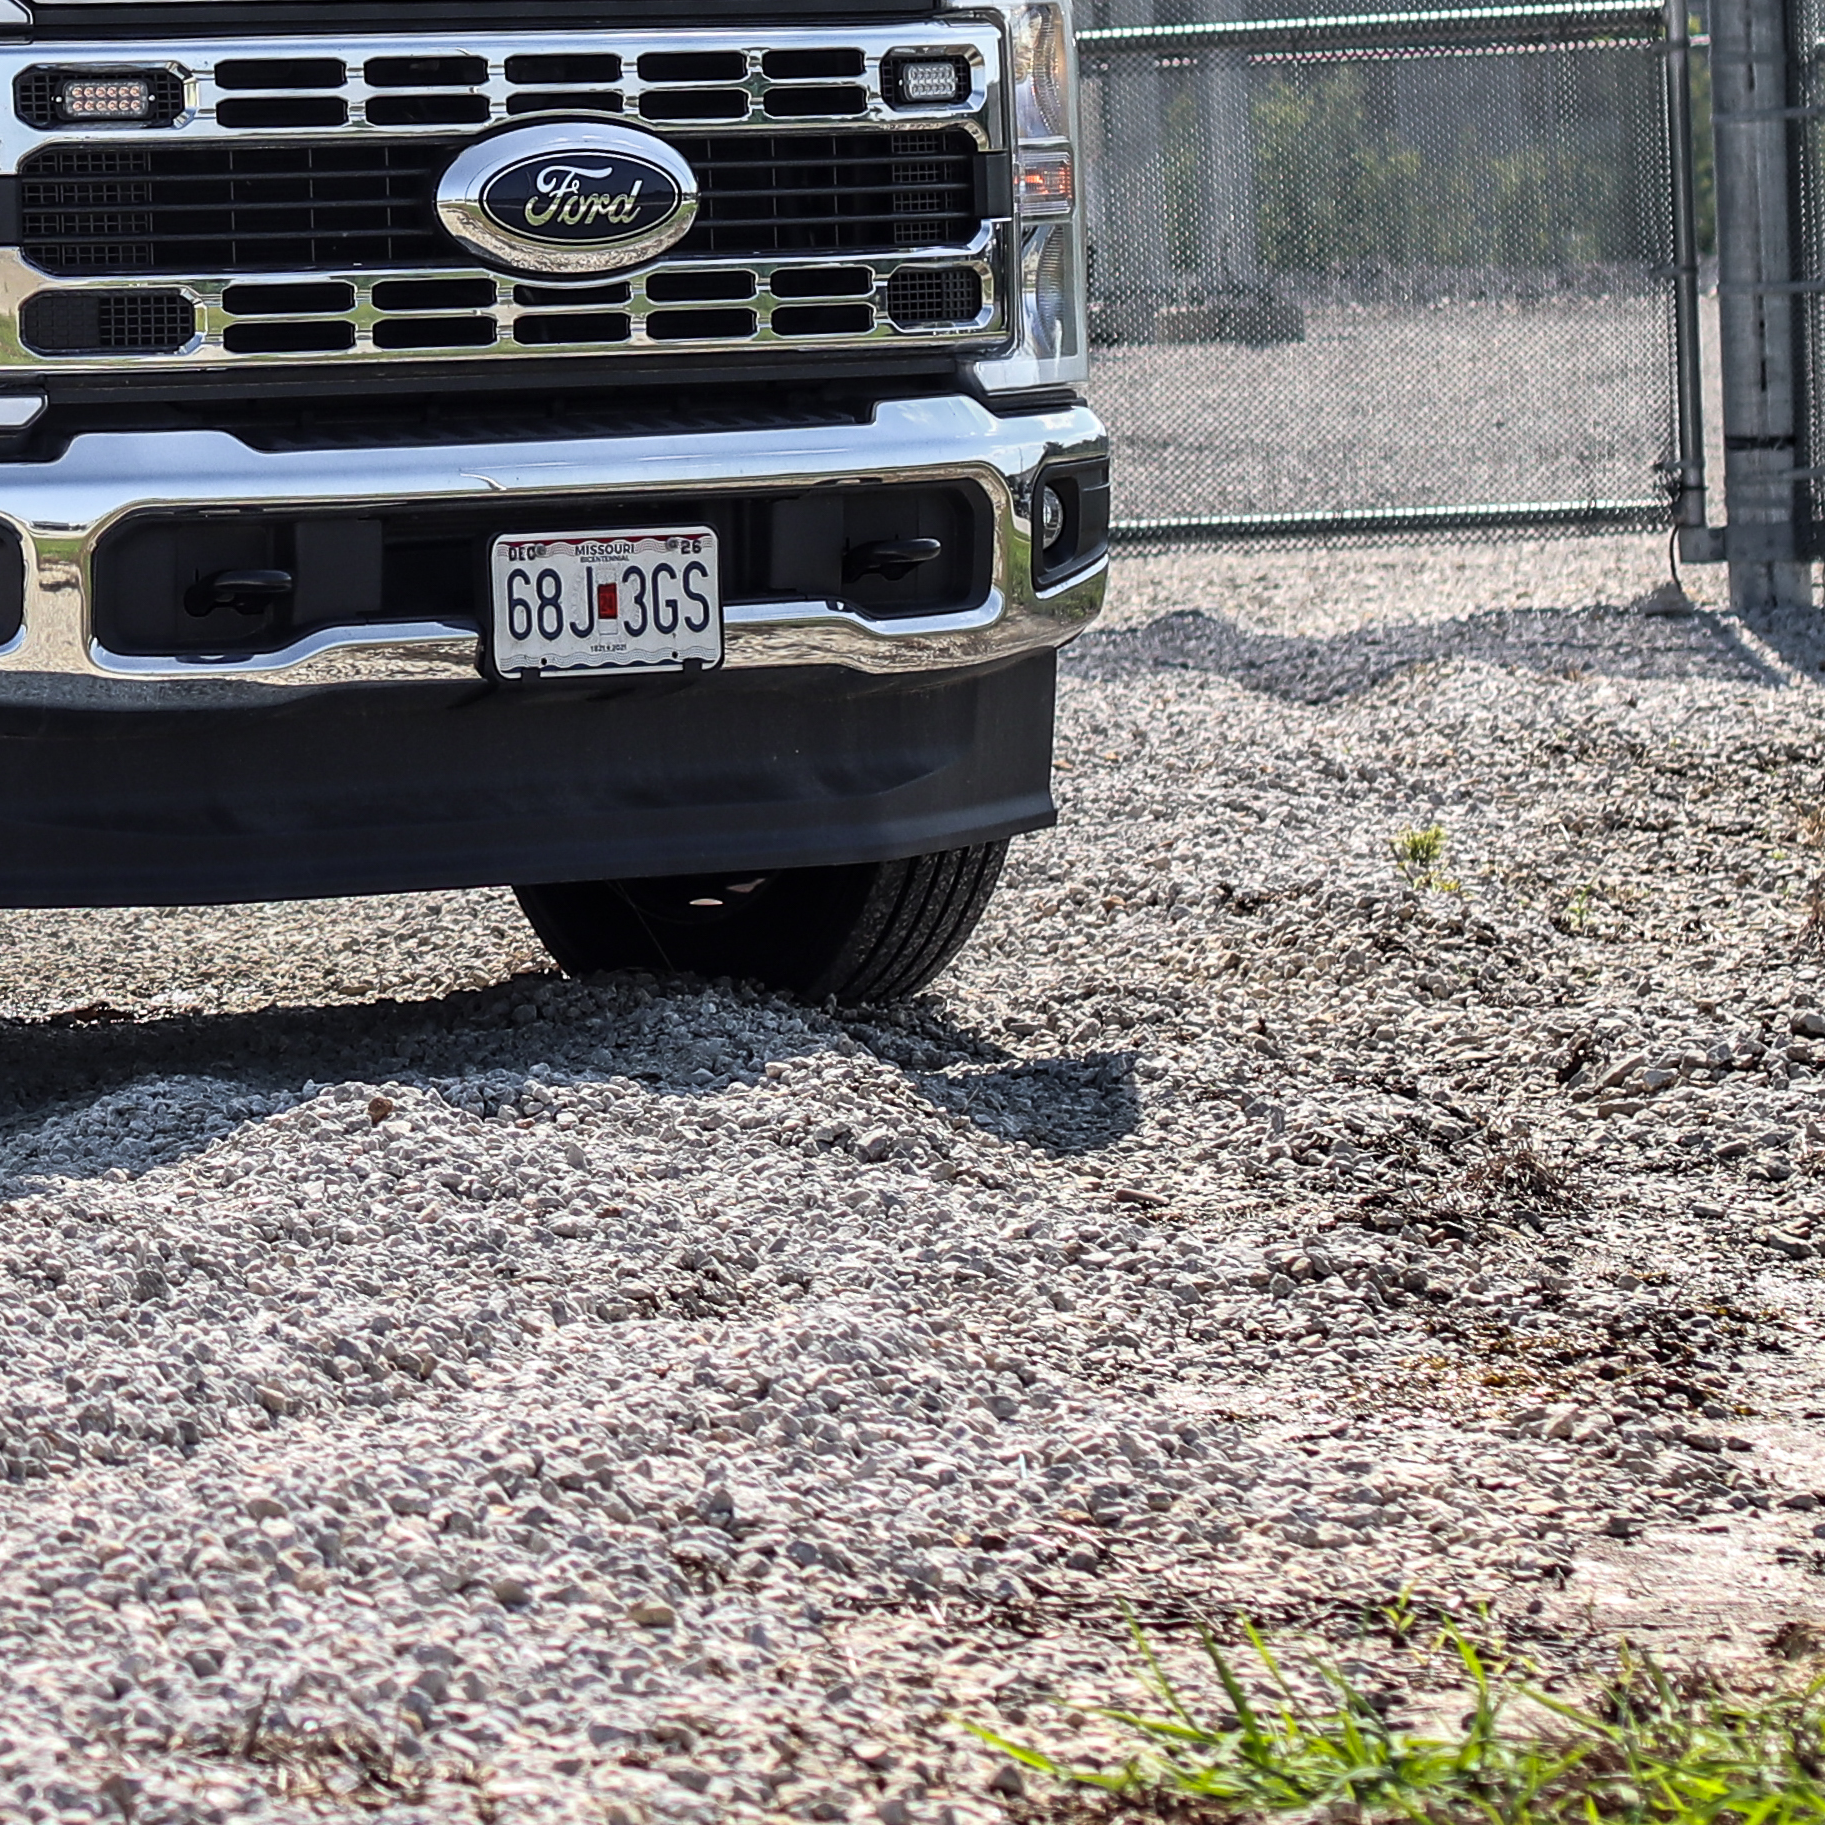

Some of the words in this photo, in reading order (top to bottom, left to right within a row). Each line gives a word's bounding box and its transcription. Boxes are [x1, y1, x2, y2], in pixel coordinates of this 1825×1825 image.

[525, 165, 644, 227] Ford
[508, 546, 536, 562] DEC
[680, 540, 702, 555] 26
[574, 543, 636, 557] MISSOURI
[579, 555, 630, 564] BICENTENNIAL
[507, 565, 595, 641] 68J
[621, 560, 710, 638] 3GS
